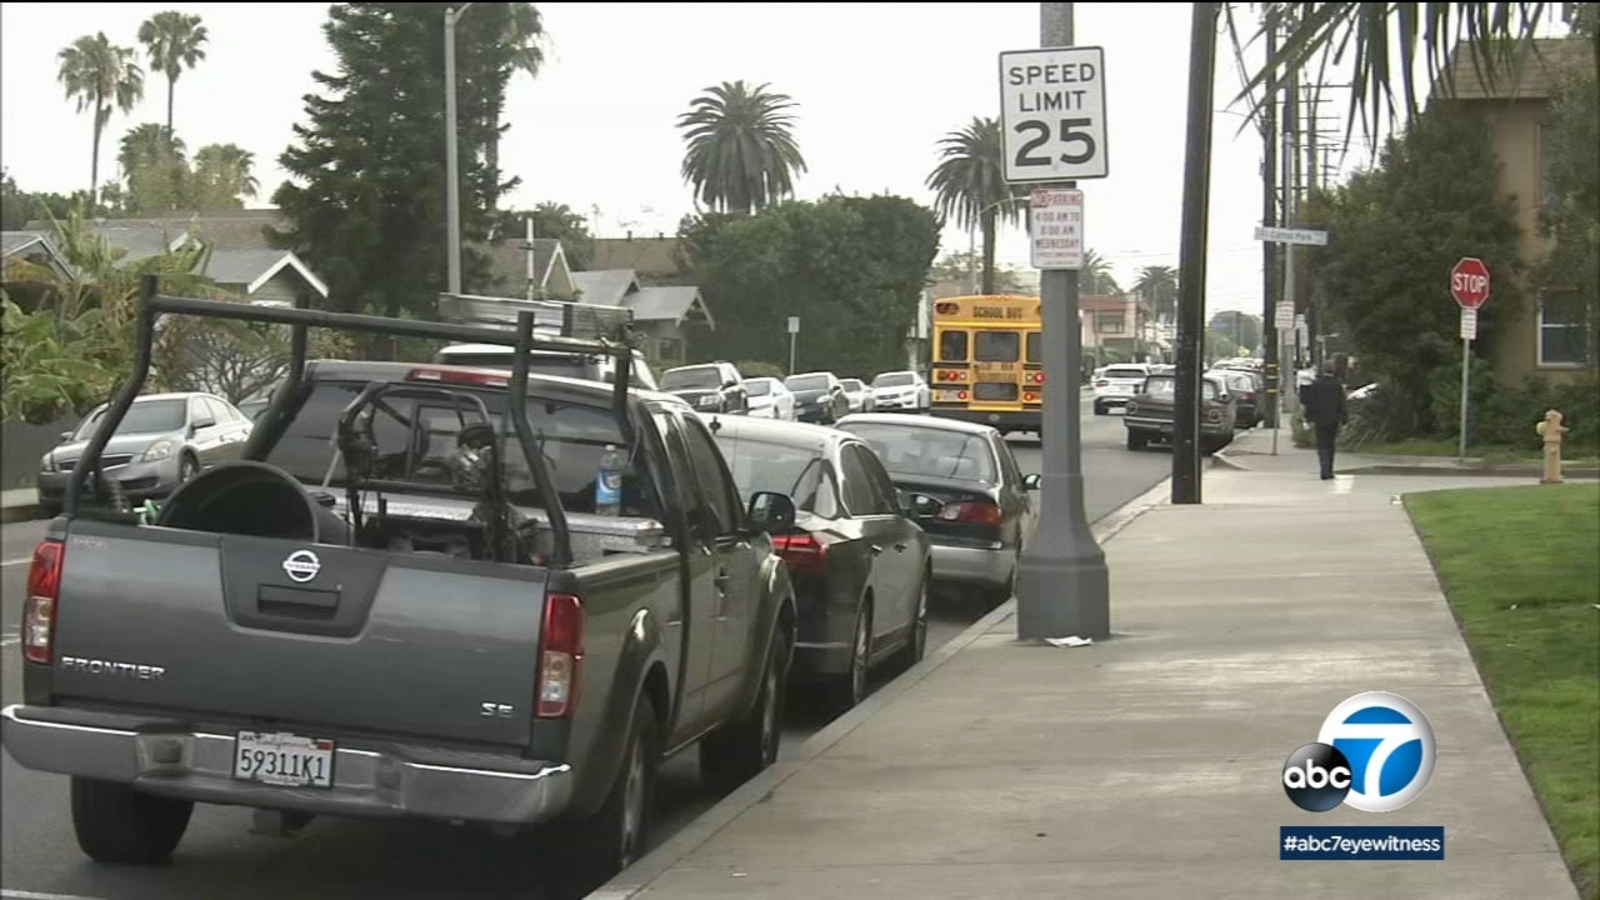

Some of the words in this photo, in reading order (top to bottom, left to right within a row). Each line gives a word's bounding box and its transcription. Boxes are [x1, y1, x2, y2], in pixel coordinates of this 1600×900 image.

[1009, 63, 1095, 85] SPEED
[1019, 90, 1086, 112] LIMIT
[1014, 118, 1096, 167] 25
[1048, 193, 1081, 206] PARKING
[1057, 211, 1068, 221] AM
[1070, 211, 1080, 221] TO
[1062, 225, 1074, 235] AM
[1035, 239, 1080, 250] WEDNESDAY
[1454, 272, 1486, 293] STOP
[973, 306, 1003, 318] SCHOOL
[1006, 307, 1023, 319] BUS
[61, 656, 165, 680] FRONTIER
[481, 702, 514, 718] SE
[240, 748, 325, 781] 59311K1
